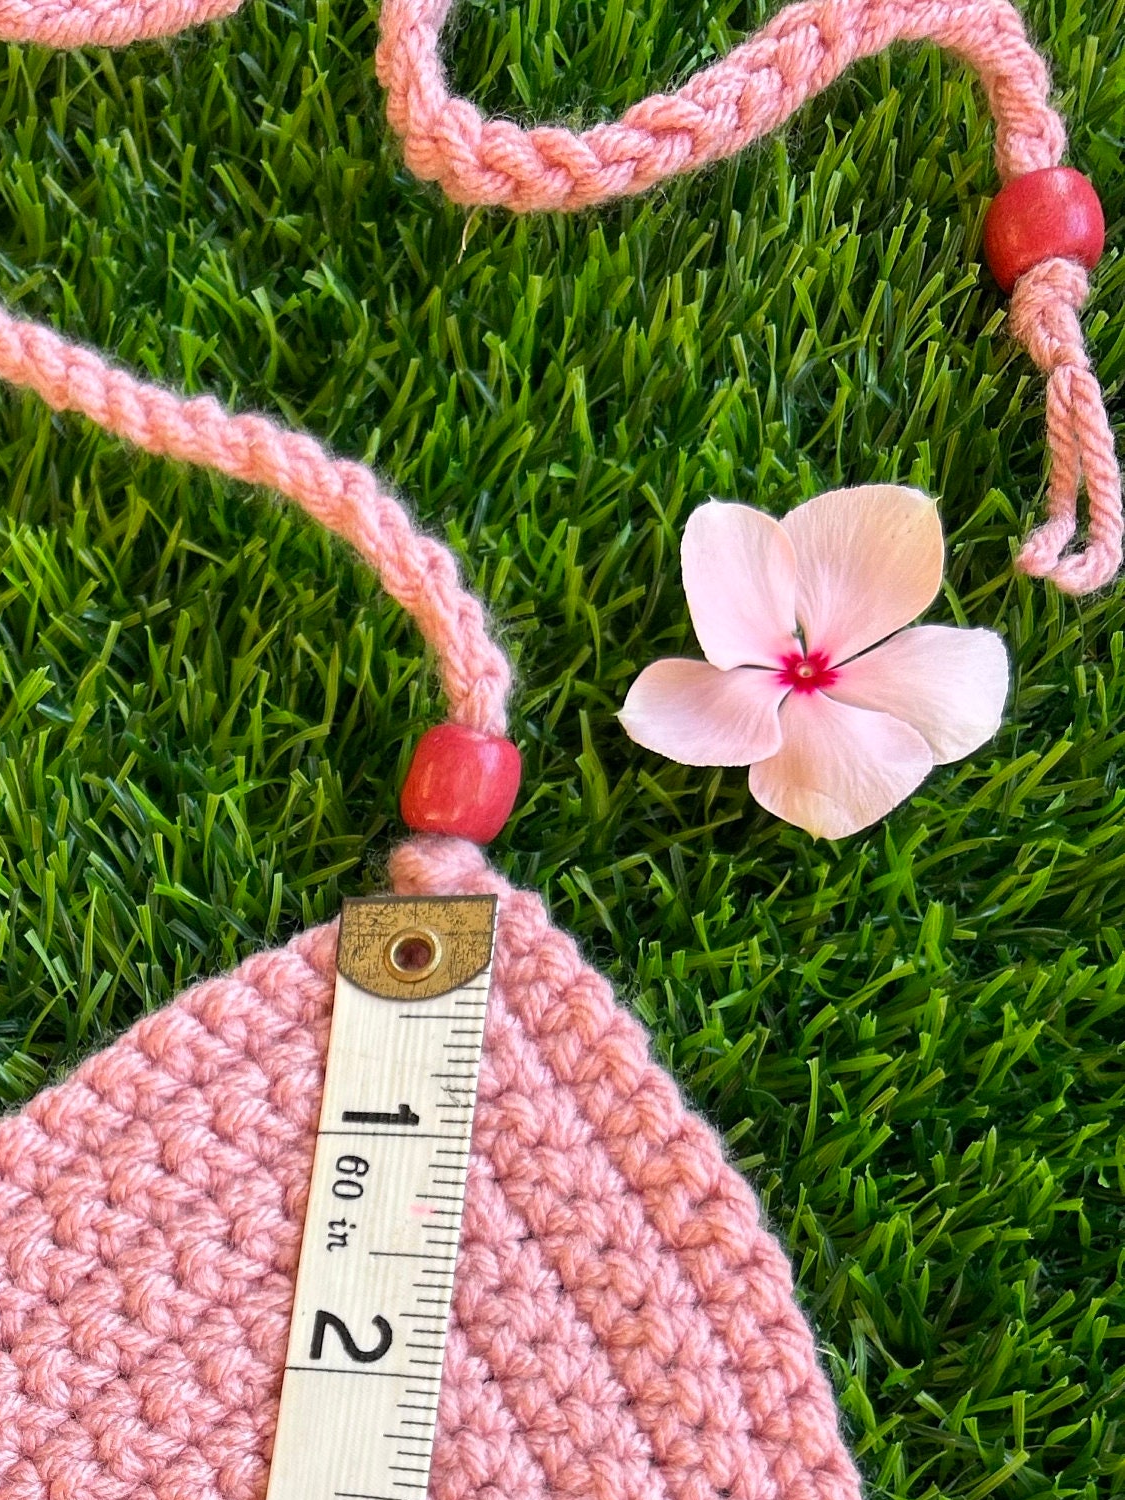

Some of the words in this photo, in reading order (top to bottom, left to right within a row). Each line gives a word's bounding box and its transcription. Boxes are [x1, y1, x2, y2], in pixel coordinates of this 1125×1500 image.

[341, 1103, 420, 1126] 1
[331, 1155, 370, 1201] 60
[326, 1217, 357, 1252] in
[309, 1310, 393, 1364] 2
